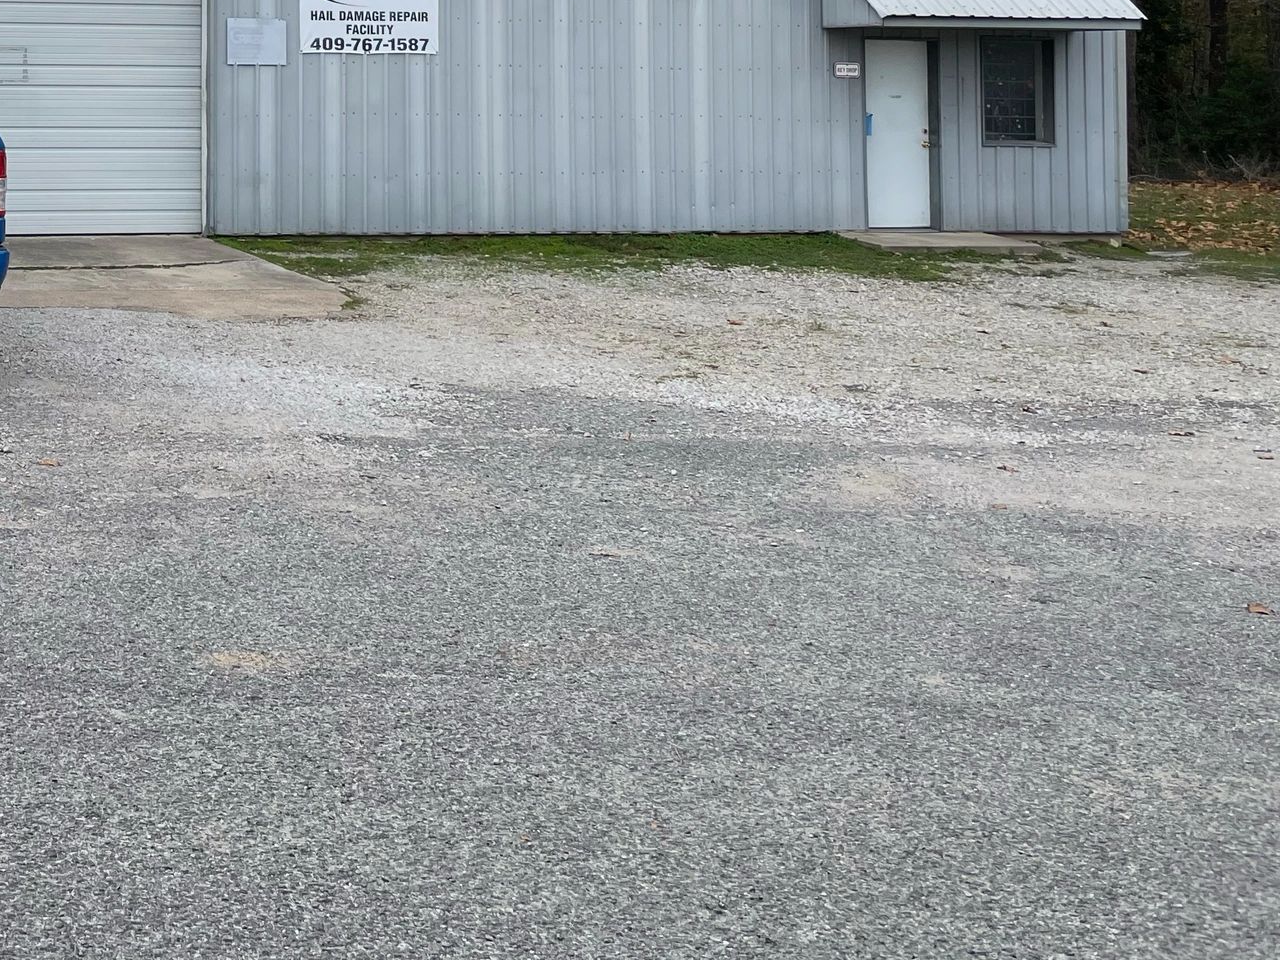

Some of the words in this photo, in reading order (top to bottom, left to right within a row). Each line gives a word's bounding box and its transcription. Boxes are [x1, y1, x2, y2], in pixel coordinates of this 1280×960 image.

[310, 10, 336, 21] HAIL
[339, 10, 386, 22] DAMAGE
[389, 11, 429, 23] REPAIR
[346, 24, 394, 35] FACILITY
[310, 37, 430, 52] 409-767-1587
